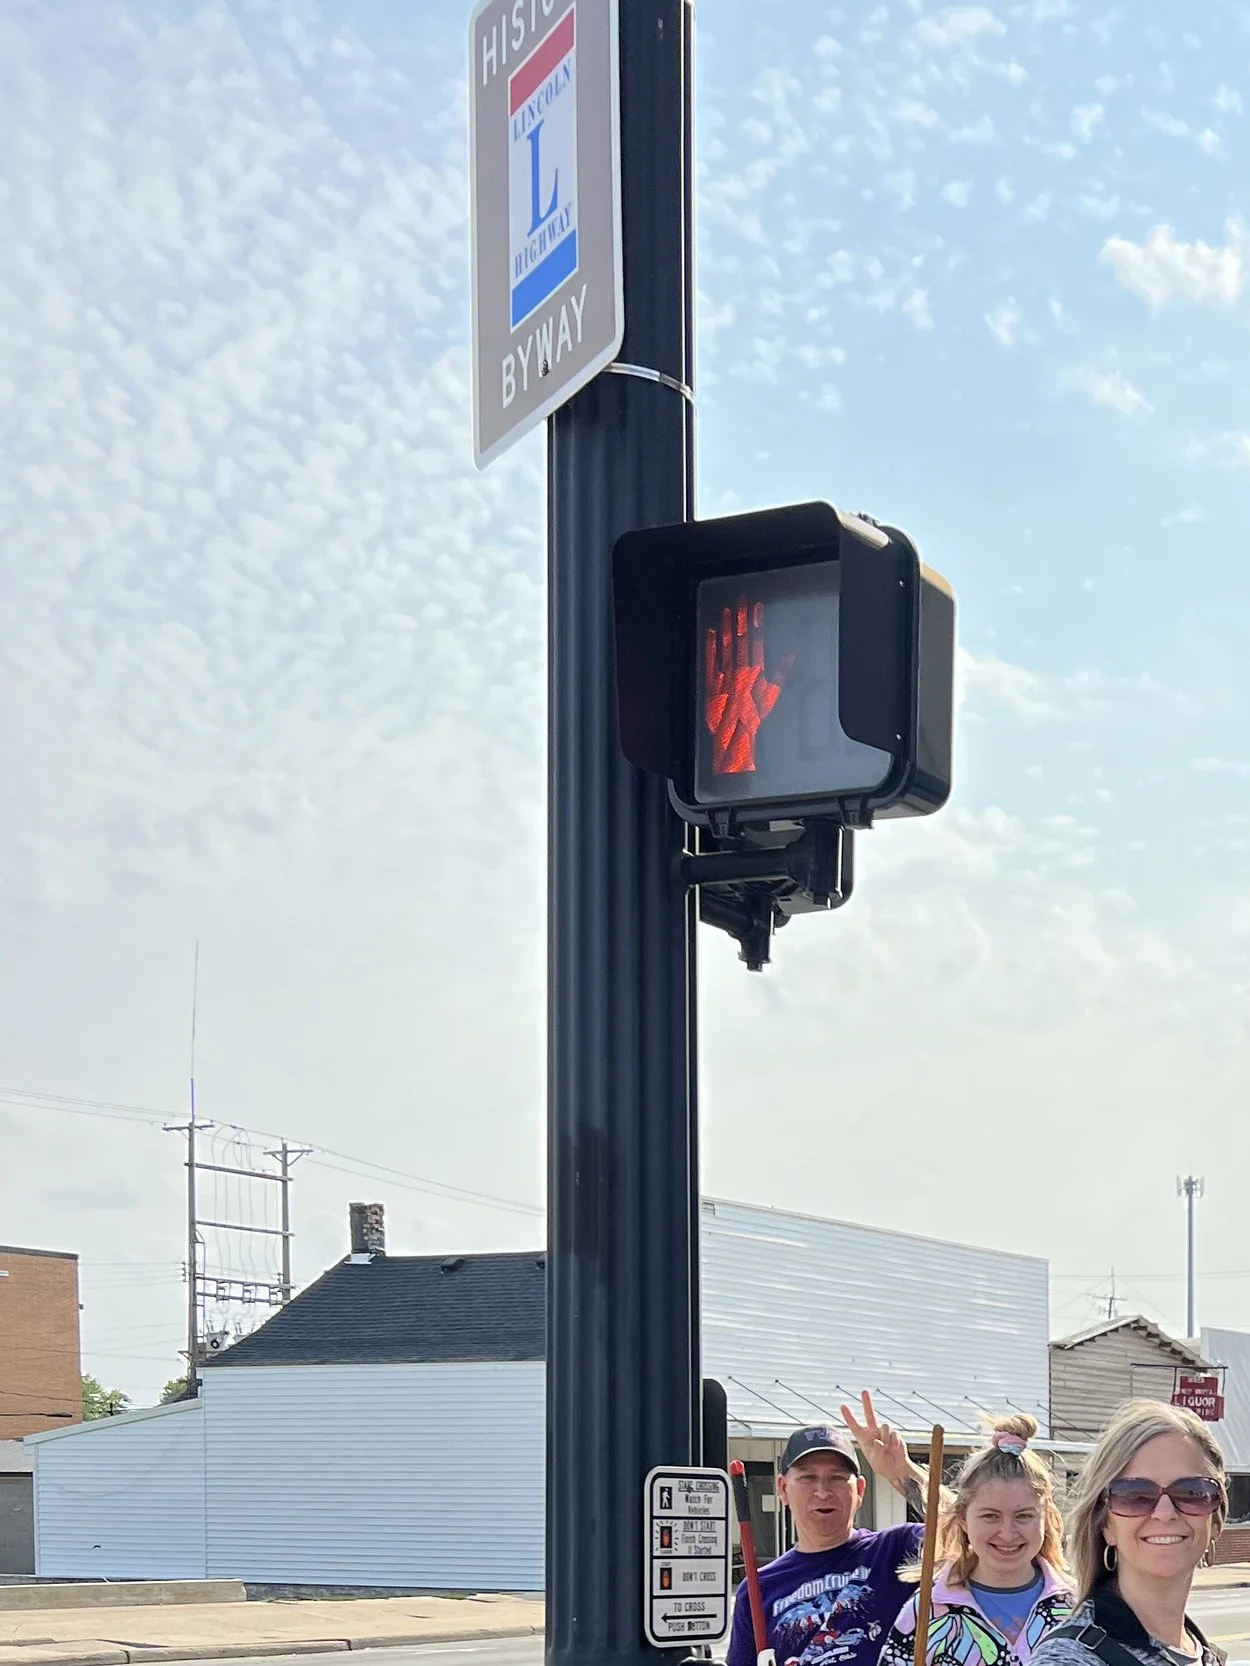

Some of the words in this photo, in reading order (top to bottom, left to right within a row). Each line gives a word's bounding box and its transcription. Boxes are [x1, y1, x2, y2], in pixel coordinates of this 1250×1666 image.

[513, 57, 571, 142] LINCOLN
[526, 118, 558, 238] L
[514, 202, 572, 279] HIGHWAY
[502, 283, 587, 409] BYWAY
[1174, 1396, 1216, 1408] LIQUOR
[668, 1621, 685, 1632] PUSH
[684, 1602, 706, 1612] CROSS
[773, 1578, 824, 1617] Freedom
